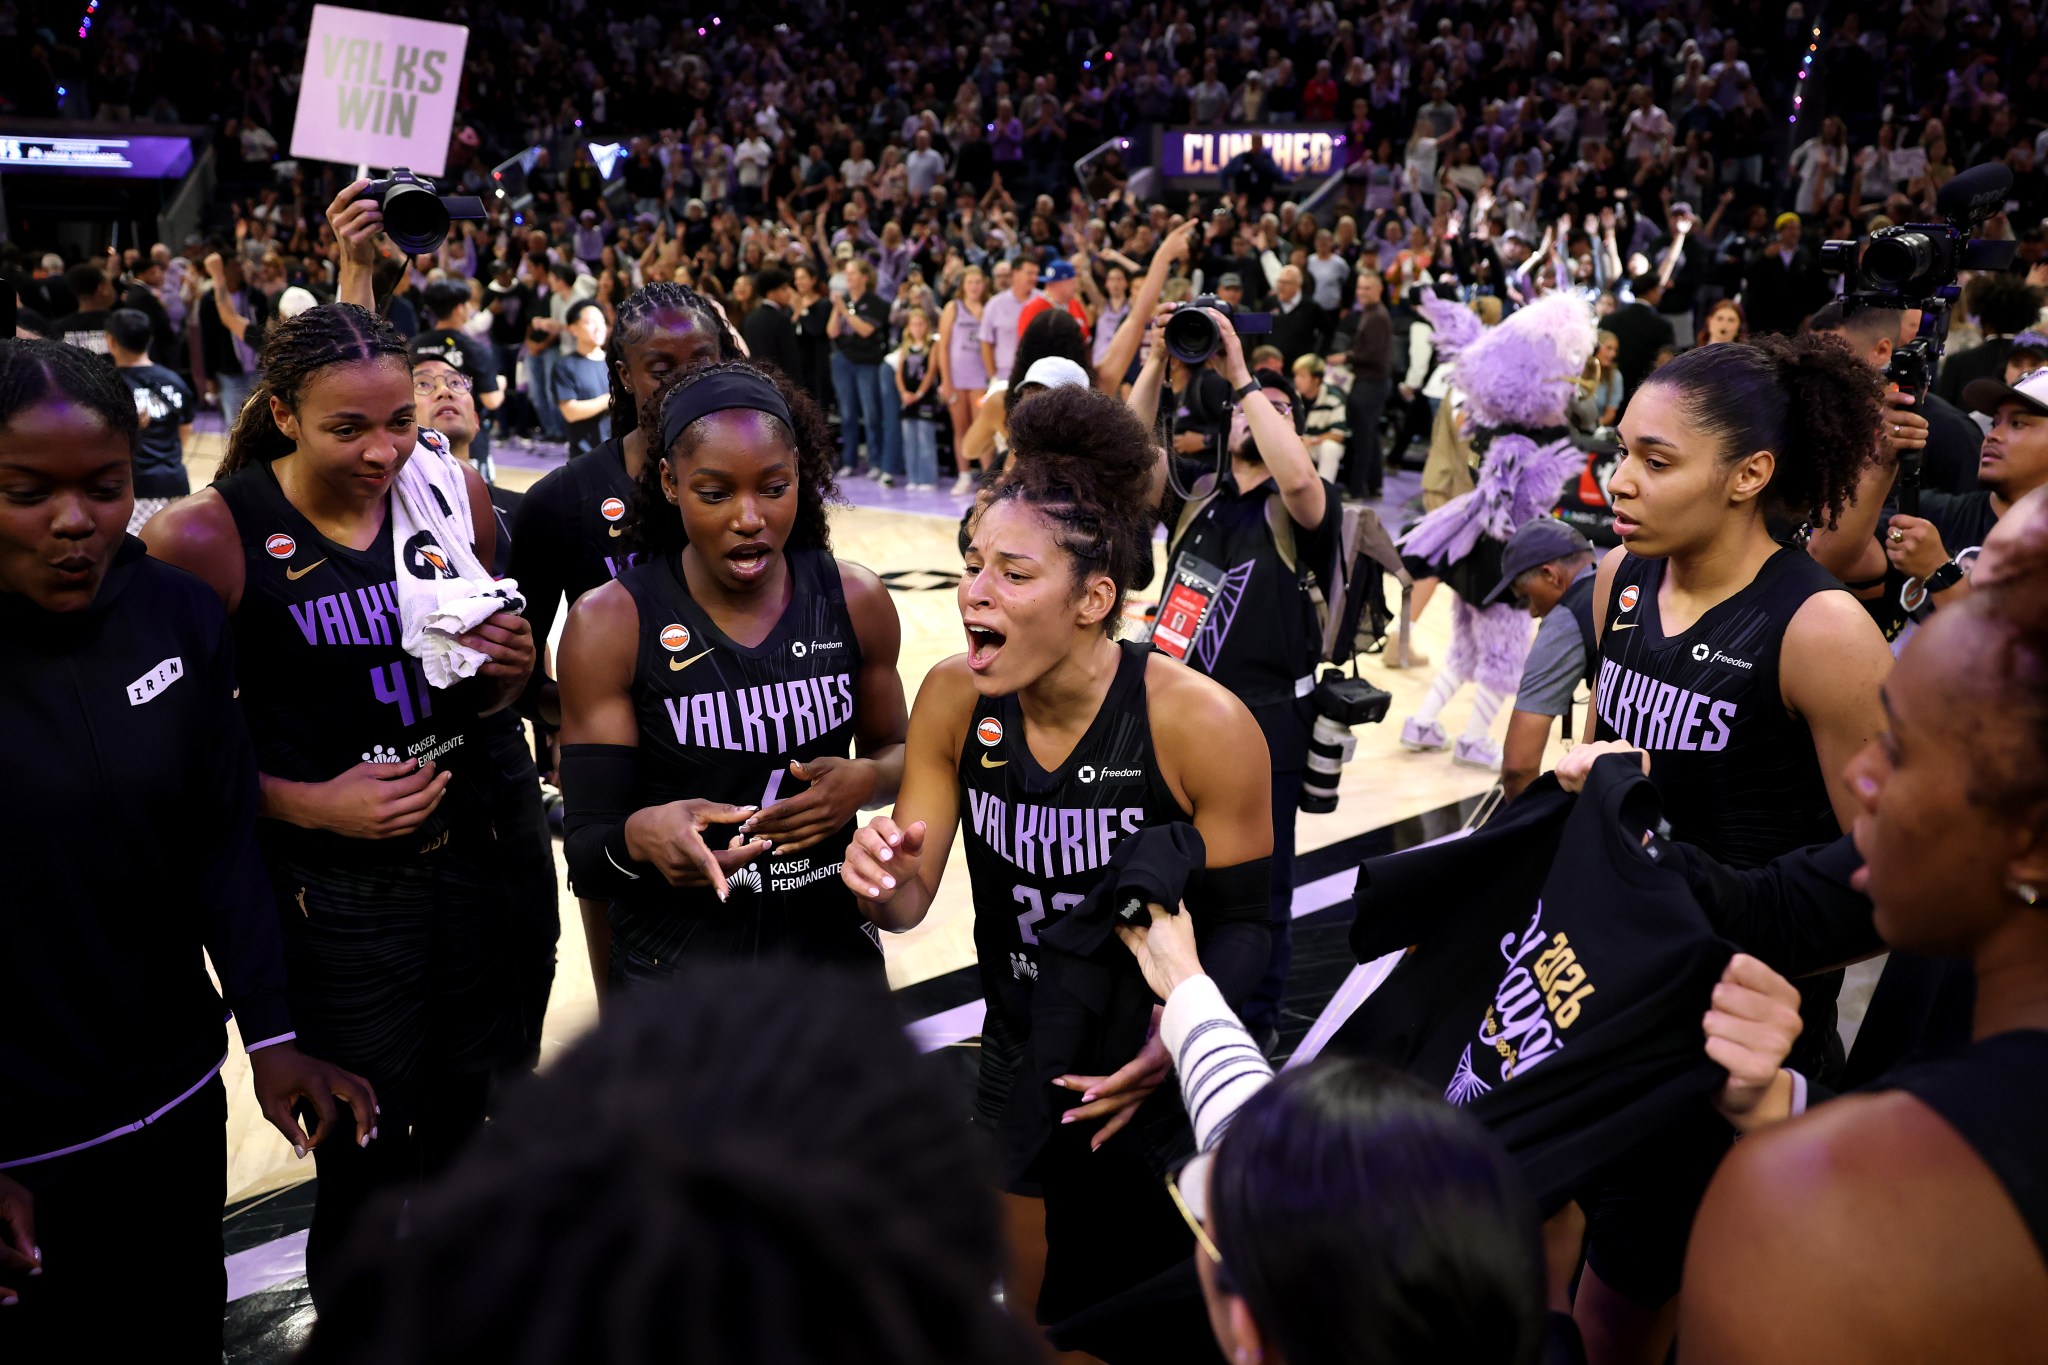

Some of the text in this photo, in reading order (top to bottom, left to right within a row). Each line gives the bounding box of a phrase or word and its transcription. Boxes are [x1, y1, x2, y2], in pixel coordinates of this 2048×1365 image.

[322, 34, 447, 95] VALKS
[337, 84, 418, 139] WIN
[1183, 132, 1334, 174] CLINHED
[811, 640, 843, 655] freedom
[1710, 650, 1754, 670] freedom
[134, 661, 179, 701] IREN
[663, 672, 853, 755] VALKYRIES
[407, 734, 437, 757] KAISER
[416, 734, 465, 769] ERMANENTE
[1099, 766, 1142, 782] freedom
[769, 858, 811, 876] KAISER
[771, 861, 844, 892] PERMANENTE
[1533, 931, 1596, 1029] 2026
